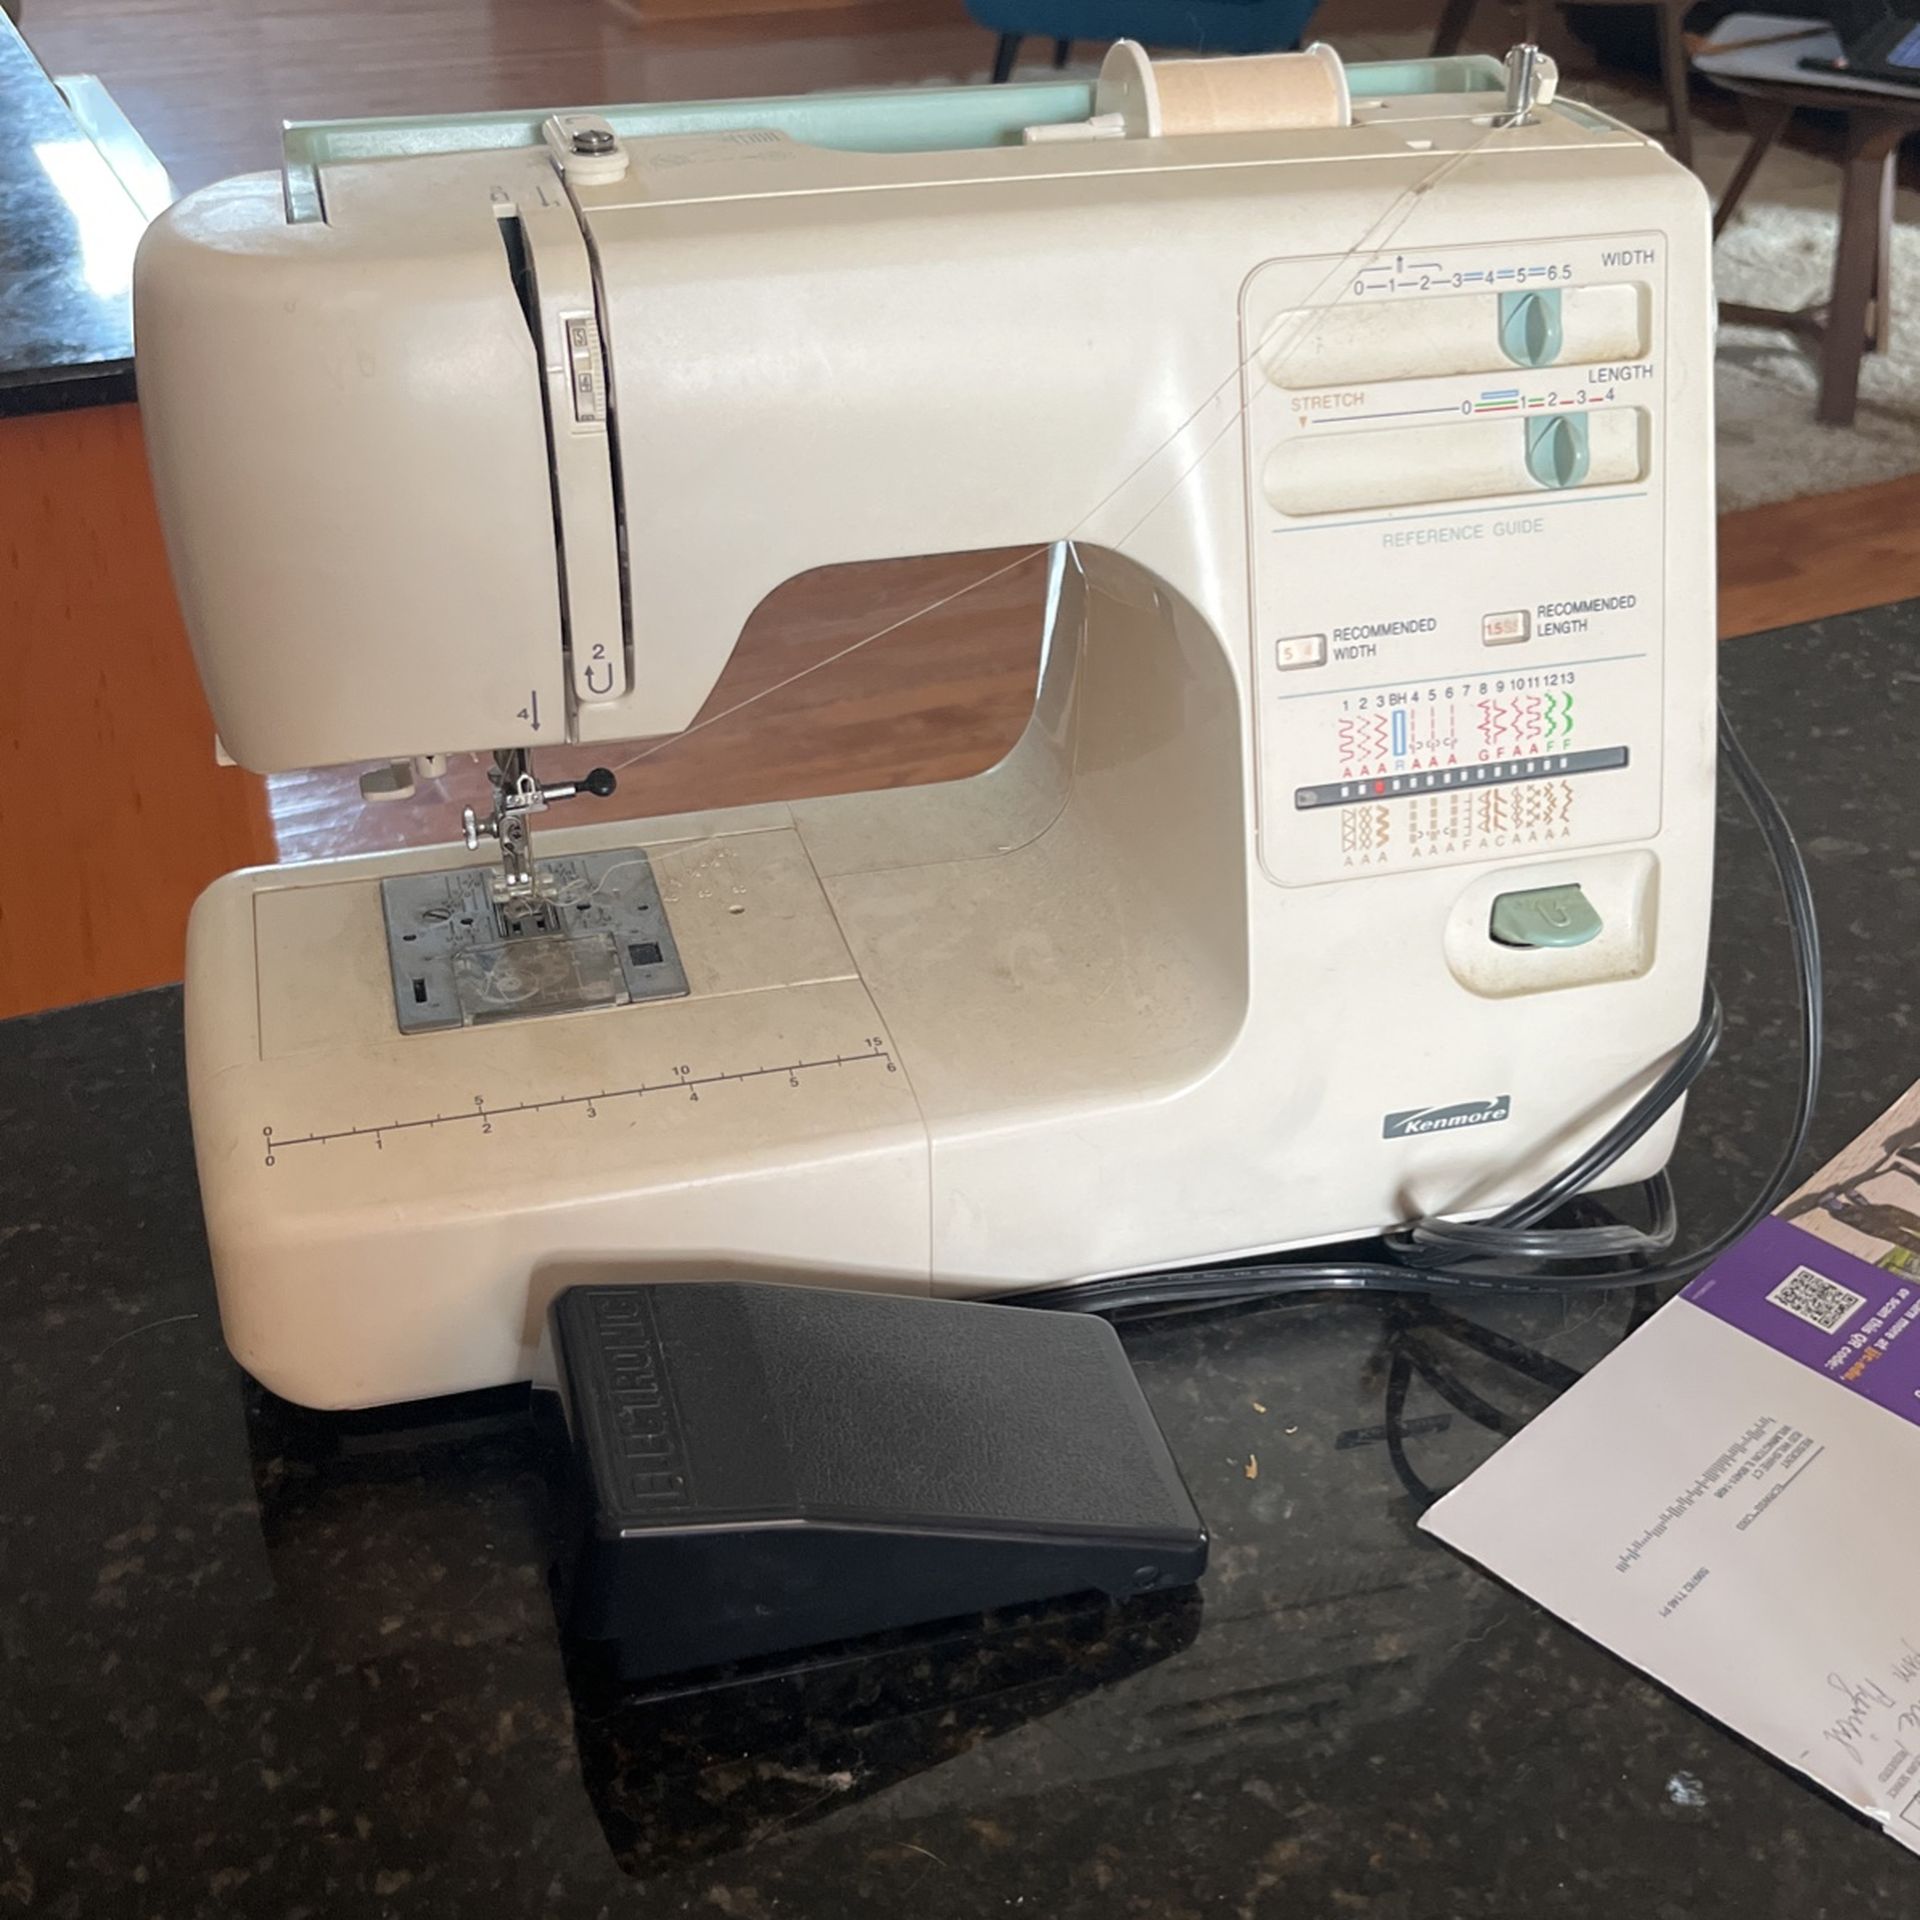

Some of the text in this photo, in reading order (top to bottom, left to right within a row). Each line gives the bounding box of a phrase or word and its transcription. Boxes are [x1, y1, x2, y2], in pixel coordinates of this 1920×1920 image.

[1601, 250, 1654, 267] WIDTH
[1353, 264, 1573, 296] 0 1 2 3 4 5 6.5
[1588, 365, 1653, 384] LENGTH
[1290, 392, 1365, 412] STRETCH
[1461, 388, 1616, 416] 0 1 2 3 4
[1382, 517, 1544, 548] REFERENCE GUIDE
[1537, 594, 1636, 618] RECOMMENDED
[1333, 618, 1437, 642] RECOMMENDED
[1537, 620, 1588, 638] LENGTH
[592, 643, 605, 660] 2
[1333, 644, 1377, 661] WIDTH
[1343, 672, 1575, 711] 1 2 3 BH 4 5 6 7 8 9 10 11 12 13
[516, 708, 529, 720] 4
[1343, 767, 1352, 778] A
[1360, 765, 1370, 775] A
[1377, 762, 1387, 773] A
[1412, 758, 1421, 769] A
[1429, 756, 1438, 767] A
[1448, 753, 1457, 764] A
[1478, 749, 1489, 761] G
[1497, 747, 1504, 758] F
[1513, 745, 1522, 756] A
[1529, 743, 1538, 754] A
[1547, 741, 1554, 752] F
[1563, 739, 1571, 750] F
[263, 1036, 883, 1137] 0 5 10 15
[265, 1062, 897, 1166] 0 1 2 3 4 5 6
[1404, 1107, 1507, 1134] Kenmore
[1824, 1288, 1910, 1370] or scan this QR code:
[1884, 1316, 1910, 1339] more
[1874, 1338, 1889, 1351] at
[1781, 1437, 1814, 1469] RESIDENT
